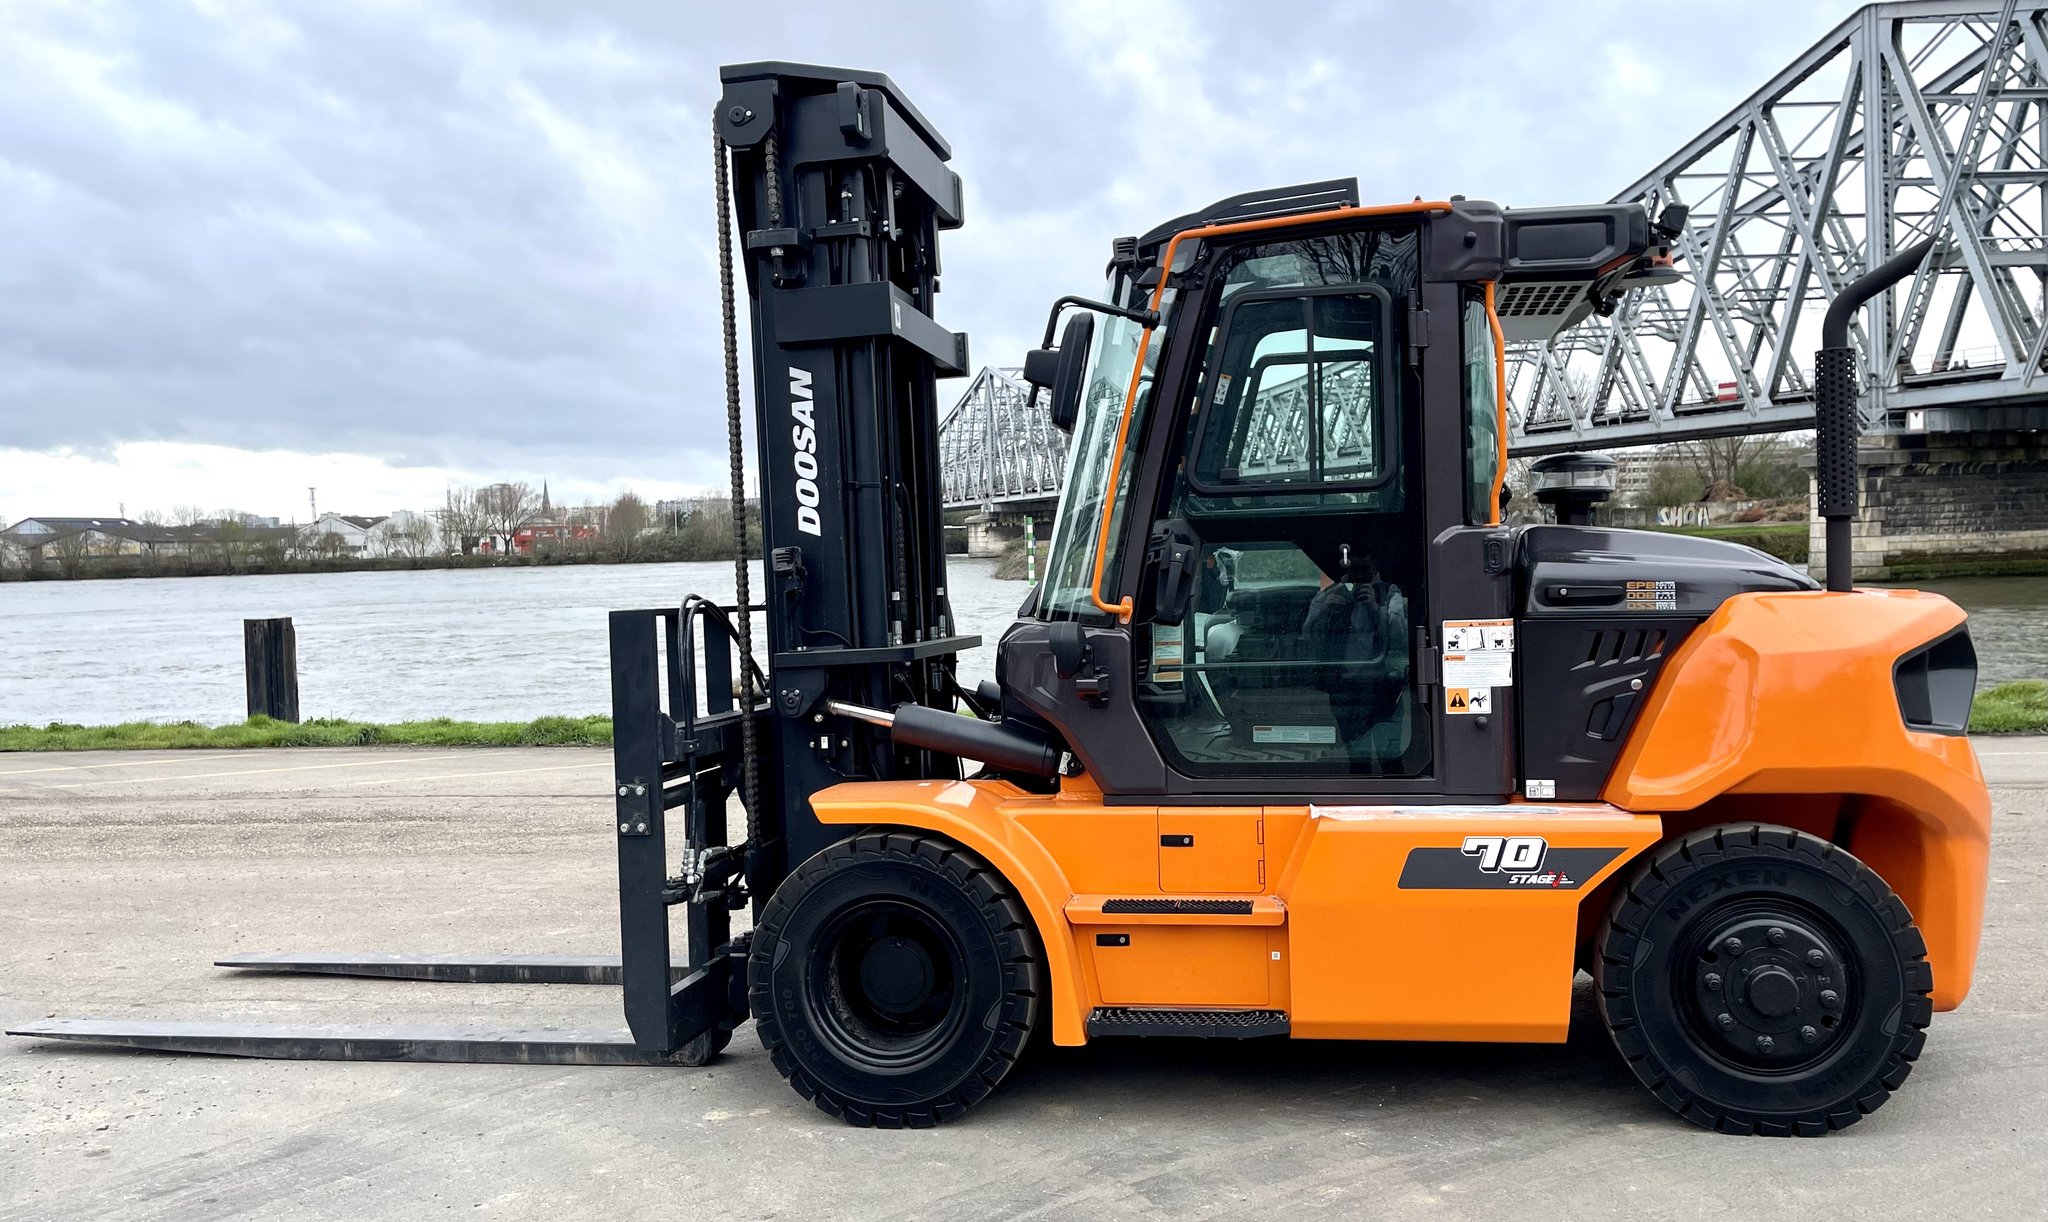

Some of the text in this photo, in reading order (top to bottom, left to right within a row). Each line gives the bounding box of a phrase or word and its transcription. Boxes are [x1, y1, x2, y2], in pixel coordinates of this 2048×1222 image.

[789, 366, 821, 536] DOOSAN
[1626, 581, 1656, 589] EPB
[1626, 602, 1656, 610] OSS
[1462, 837, 1548, 872] 70
[1509, 875, 1556, 884] STAGE
[1665, 868, 1788, 921] NEXEN
